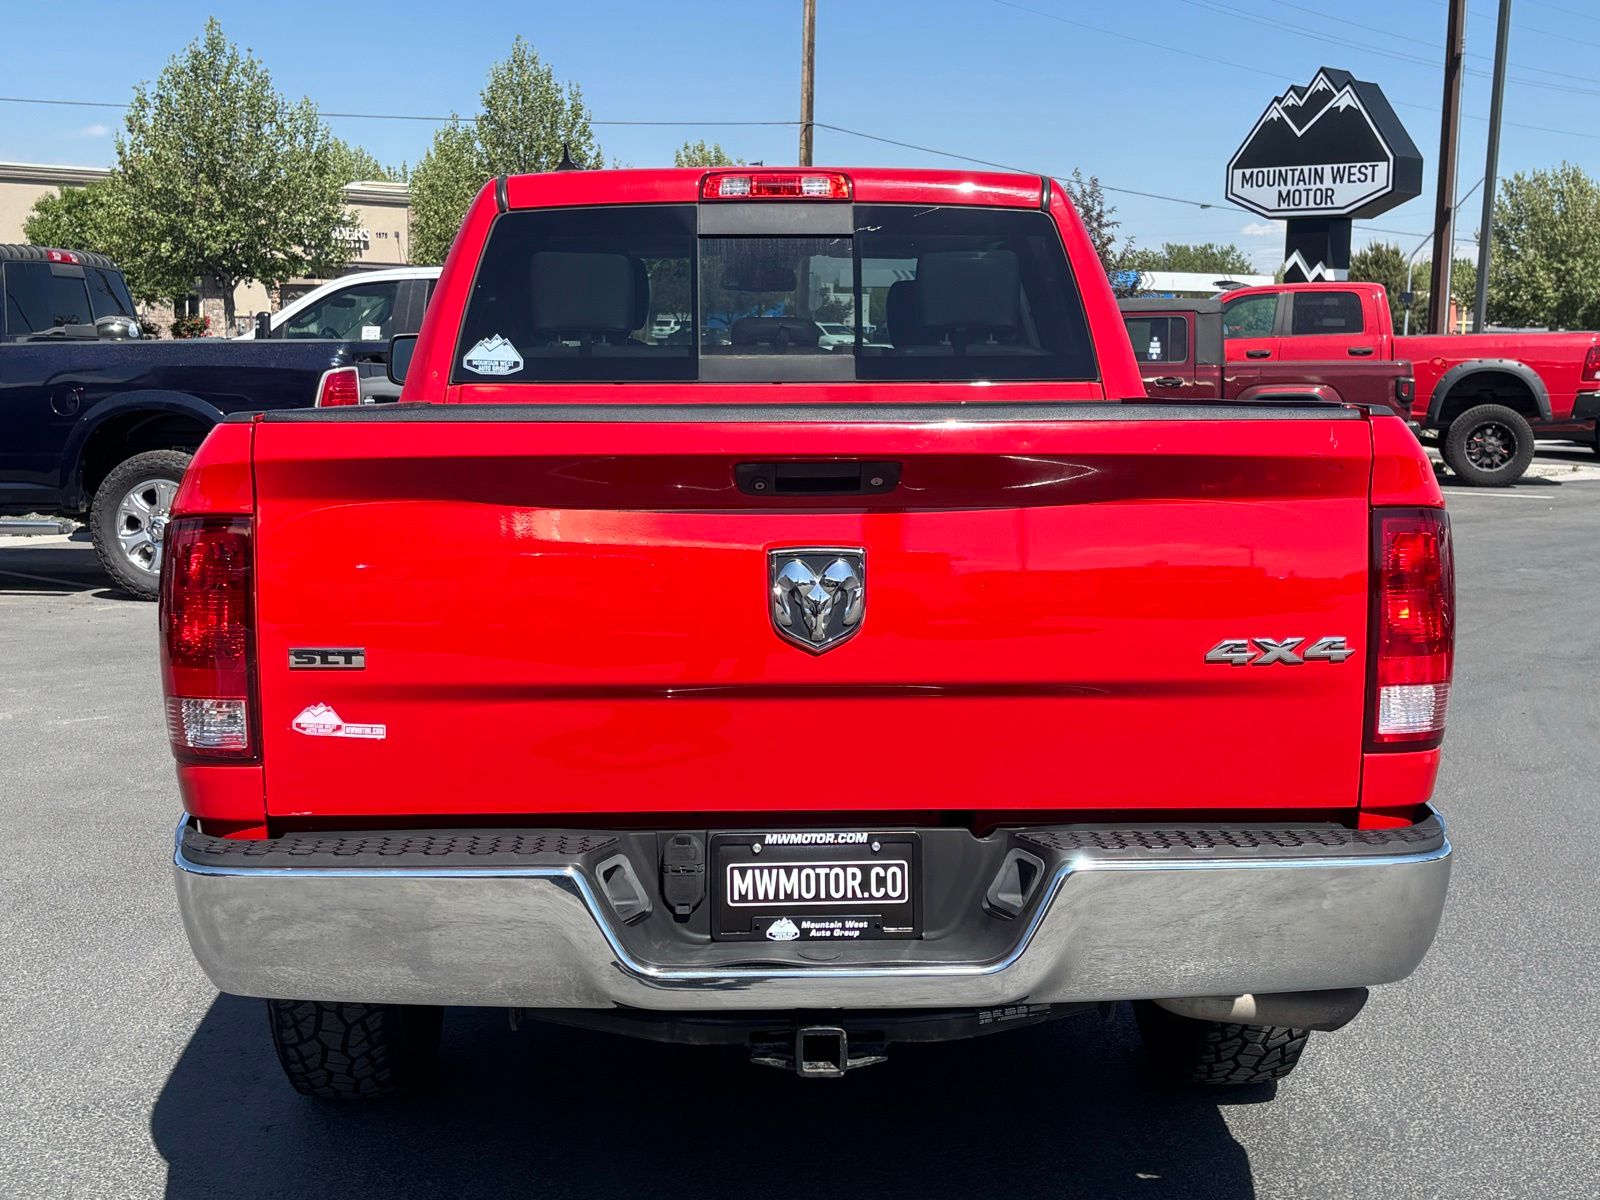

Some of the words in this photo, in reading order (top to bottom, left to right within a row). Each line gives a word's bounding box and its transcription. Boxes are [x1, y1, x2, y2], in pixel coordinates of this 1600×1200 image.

[1240, 166, 1325, 189] MOUNTAIN
[1330, 164, 1379, 185] WEST
[1277, 187, 1335, 208] MOTOR
[293, 649, 362, 665] SLT
[764, 832, 868, 845] MWMOTOR.COM
[733, 866, 902, 901] MWMOTOR.CO
[801, 920, 842, 929] Mountain
[845, 920, 868, 929] West
[810, 929, 831, 937] Auto
[833, 929, 860, 938] Group
